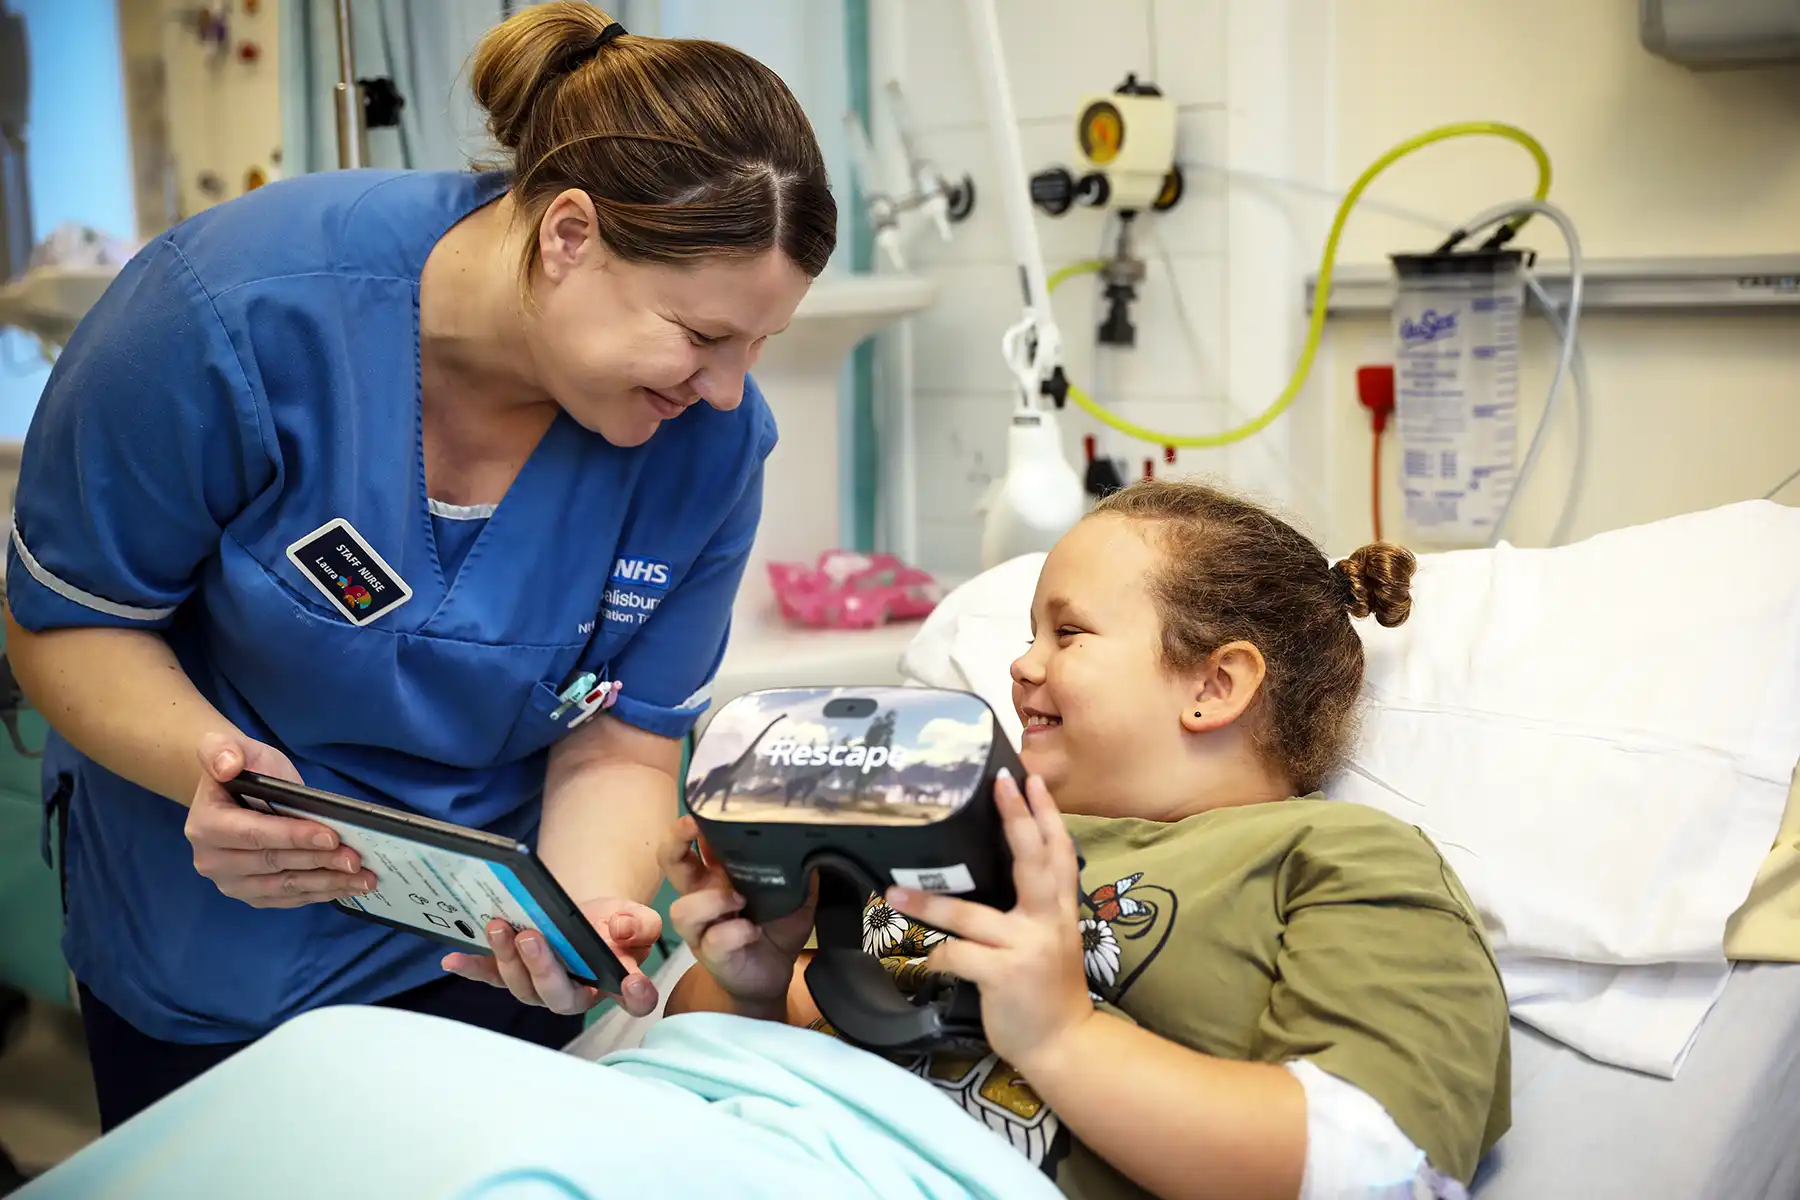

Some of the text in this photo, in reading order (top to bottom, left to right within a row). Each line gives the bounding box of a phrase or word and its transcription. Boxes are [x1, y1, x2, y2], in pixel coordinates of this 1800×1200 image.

[315, 556, 339, 580] Laura
[335, 543, 385, 593] STAFF NURSE
[613, 558, 669, 584] NHS
[601, 589, 664, 610] alisbur
